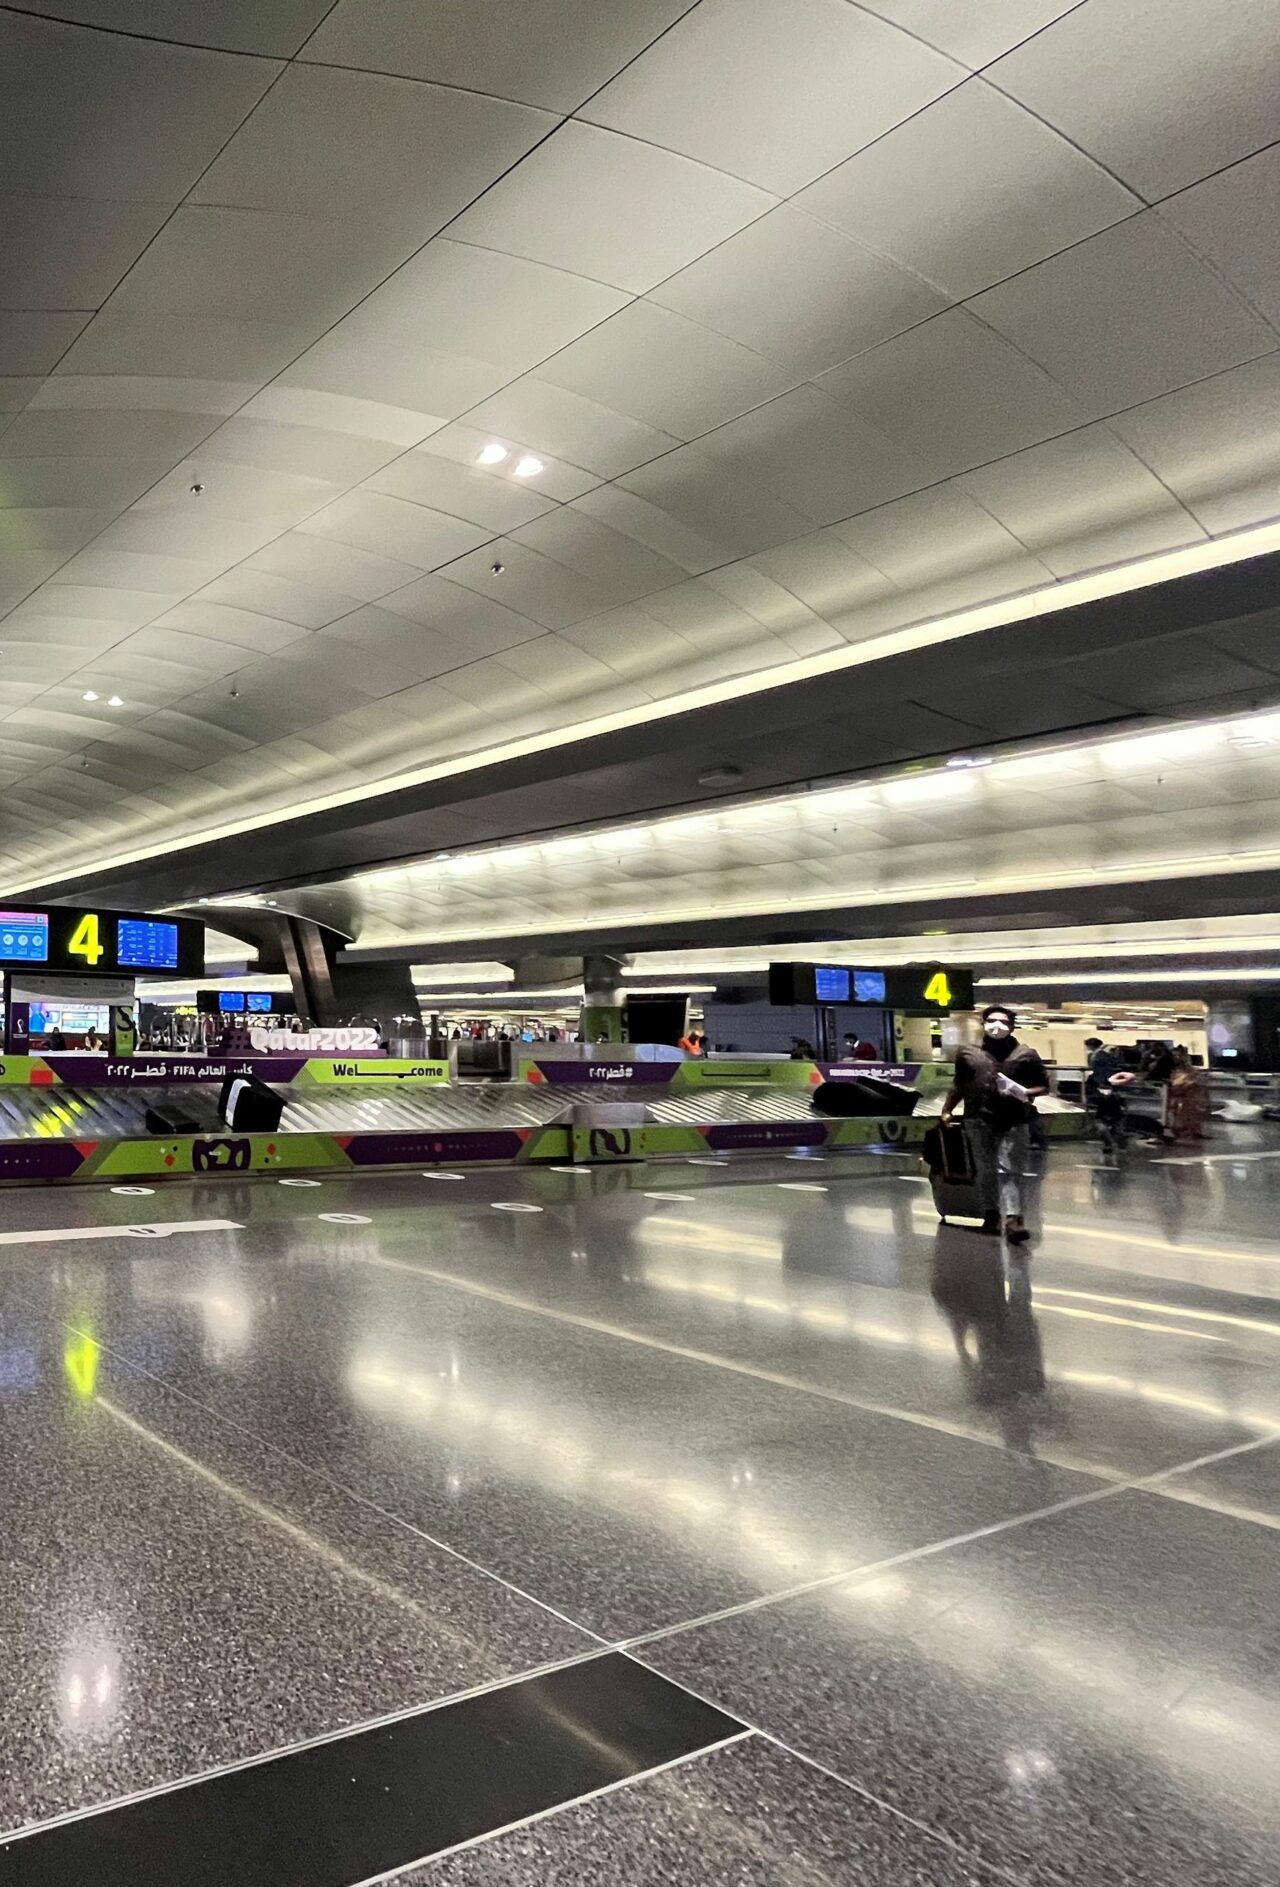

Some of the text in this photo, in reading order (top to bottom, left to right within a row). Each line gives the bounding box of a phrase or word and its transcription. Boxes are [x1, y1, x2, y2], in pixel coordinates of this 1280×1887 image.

[69, 914, 103, 964] 4
[924, 973, 952, 1007] 4
[173, 1065, 196, 1076] FIFA
[198, 1065, 226, 1078] العالم
